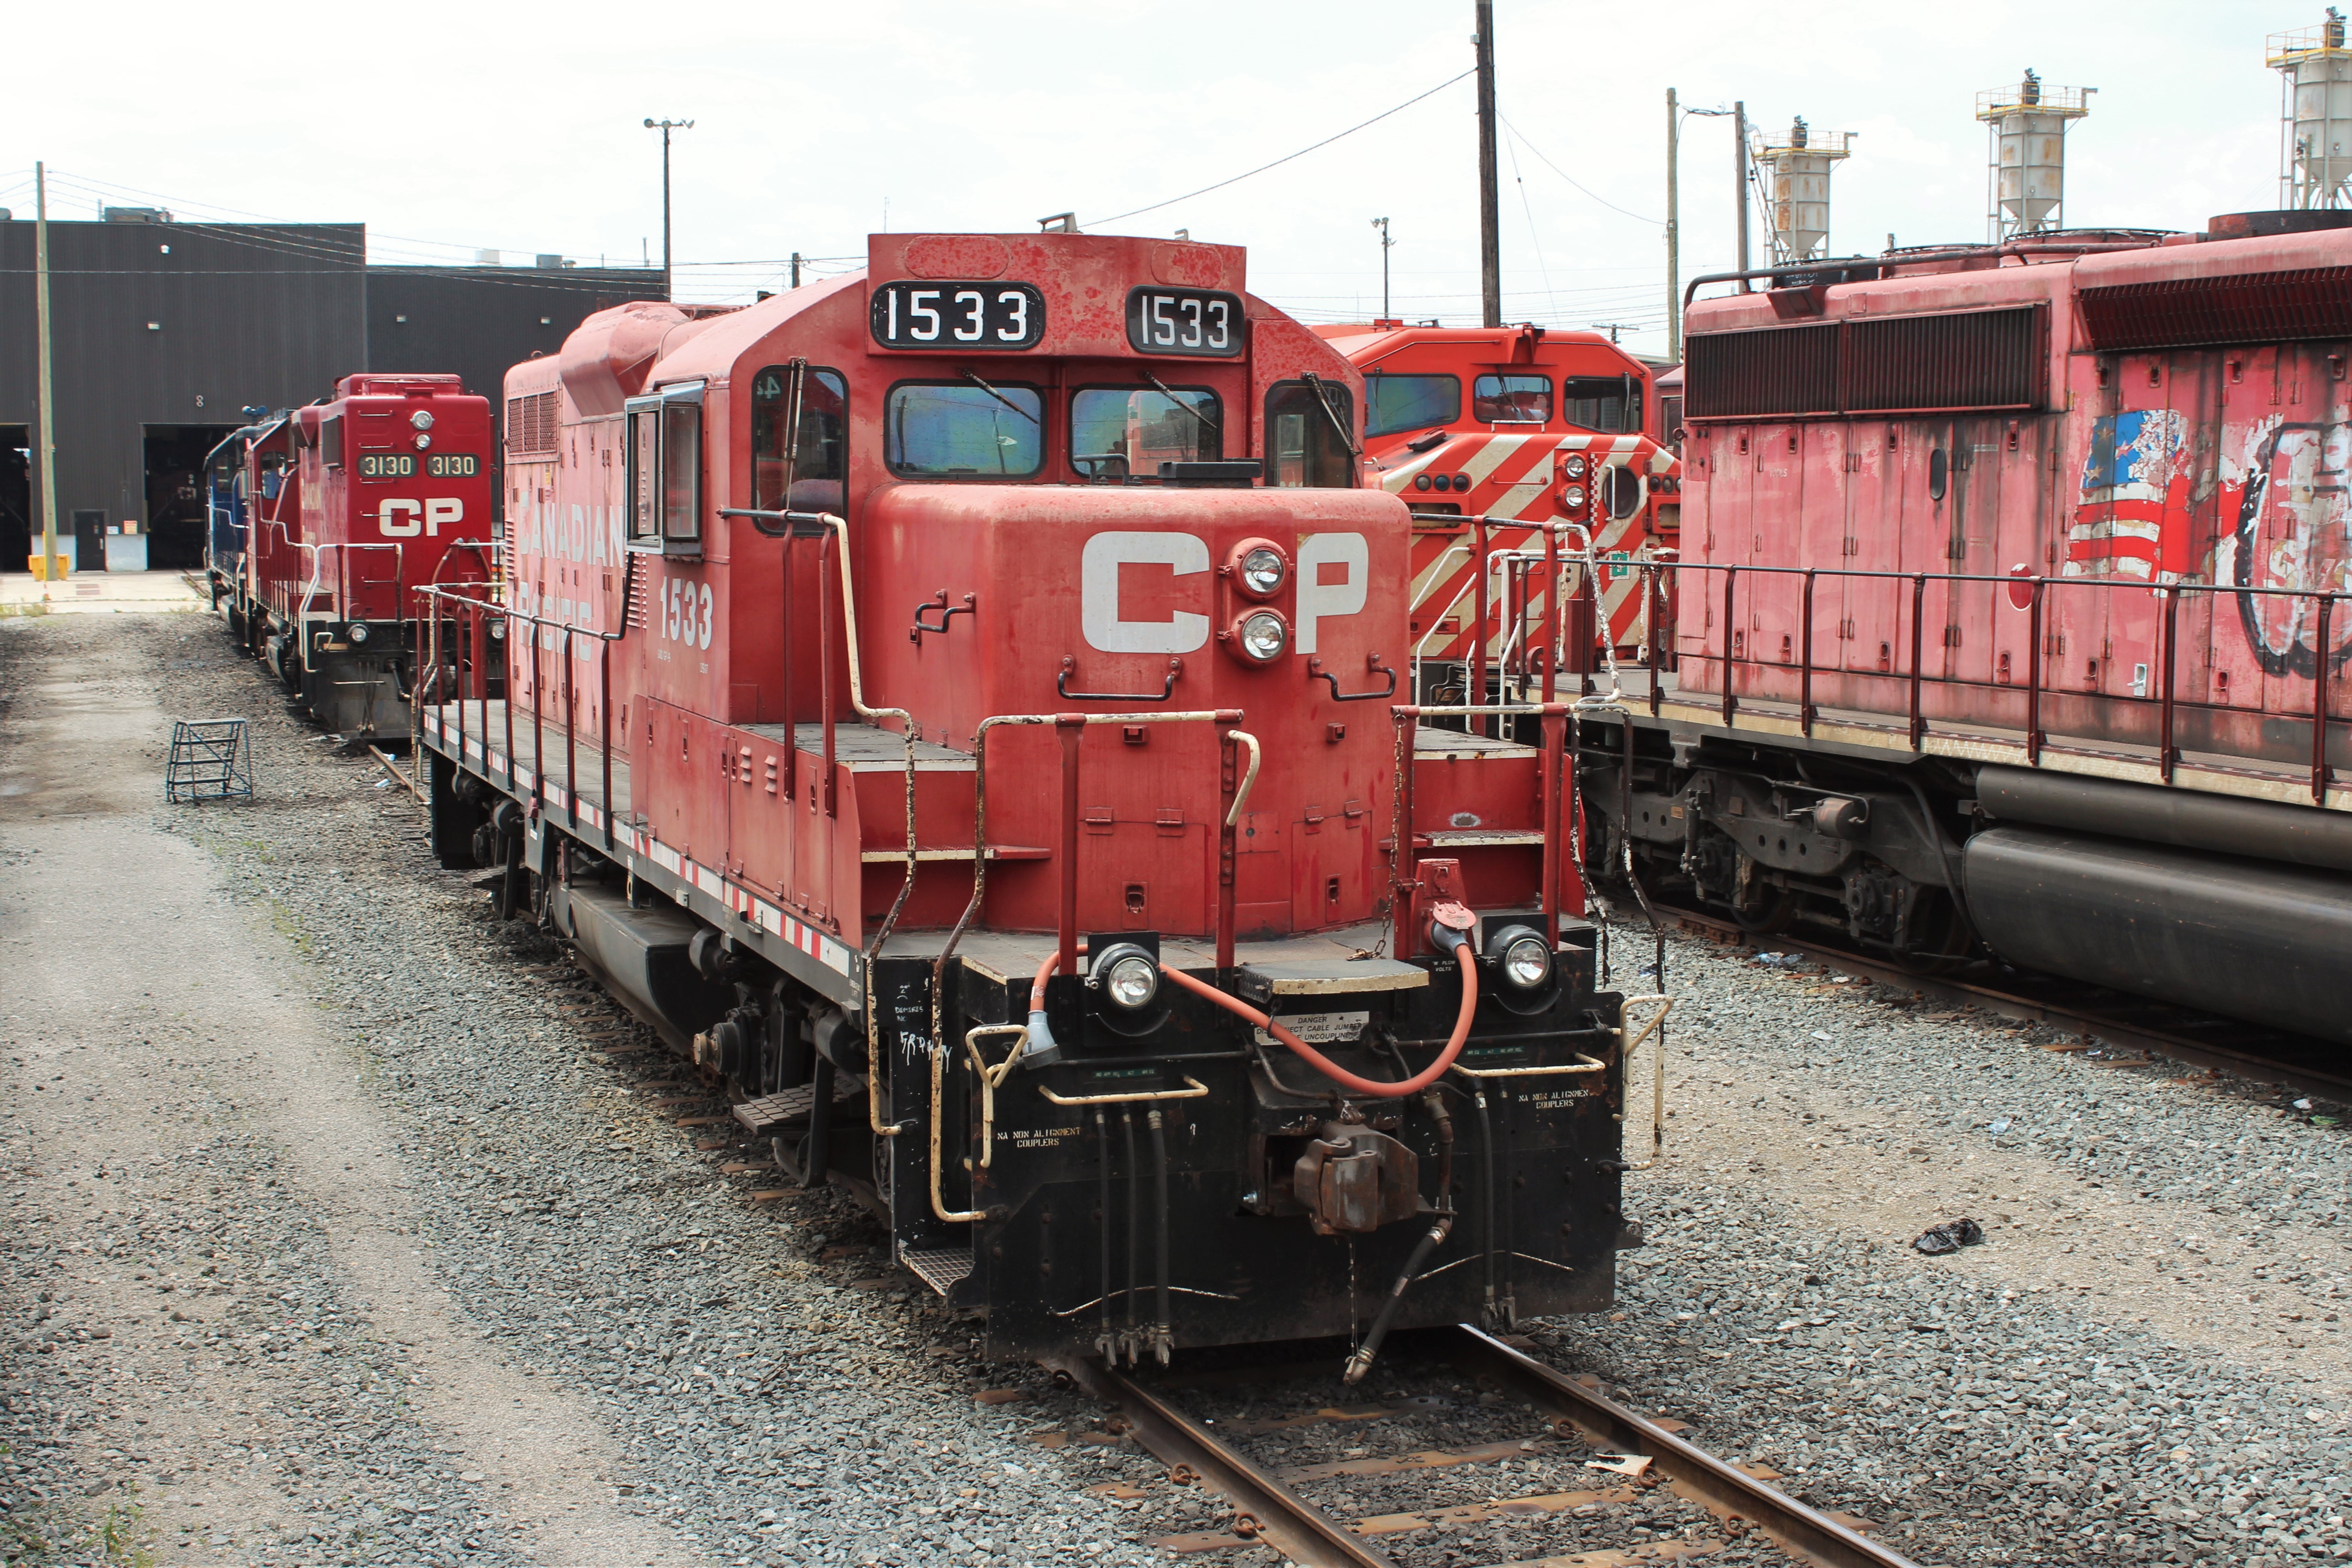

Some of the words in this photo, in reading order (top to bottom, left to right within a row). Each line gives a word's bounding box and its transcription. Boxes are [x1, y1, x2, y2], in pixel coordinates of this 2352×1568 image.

[888, 290, 1027, 341] 1533
[1142, 295, 1229, 348] 1533
[196, 395, 204, 407] 8
[365, 457, 411, 475] 3130
[433, 457, 474, 475] 3130
[379, 498, 463, 537] CP
[519, 491, 624, 568] CANADIAN
[1081, 531, 1369, 654] CP
[519, 581, 592, 662] PACIFIC
[660, 576, 713, 651] 1533
[1256, 1026, 1304, 1034] DIECT
[1551, 1089, 1589, 1099] ALIGNMEN
[1536, 1099, 1574, 1109] COUPLERS
[997, 1132, 1008, 1140] NA
[1013, 1131, 1029, 1139] NON
[1034, 1127, 1081, 1138] ALIGNMENT
[1017, 1138, 1059, 1148] COUPLERS
